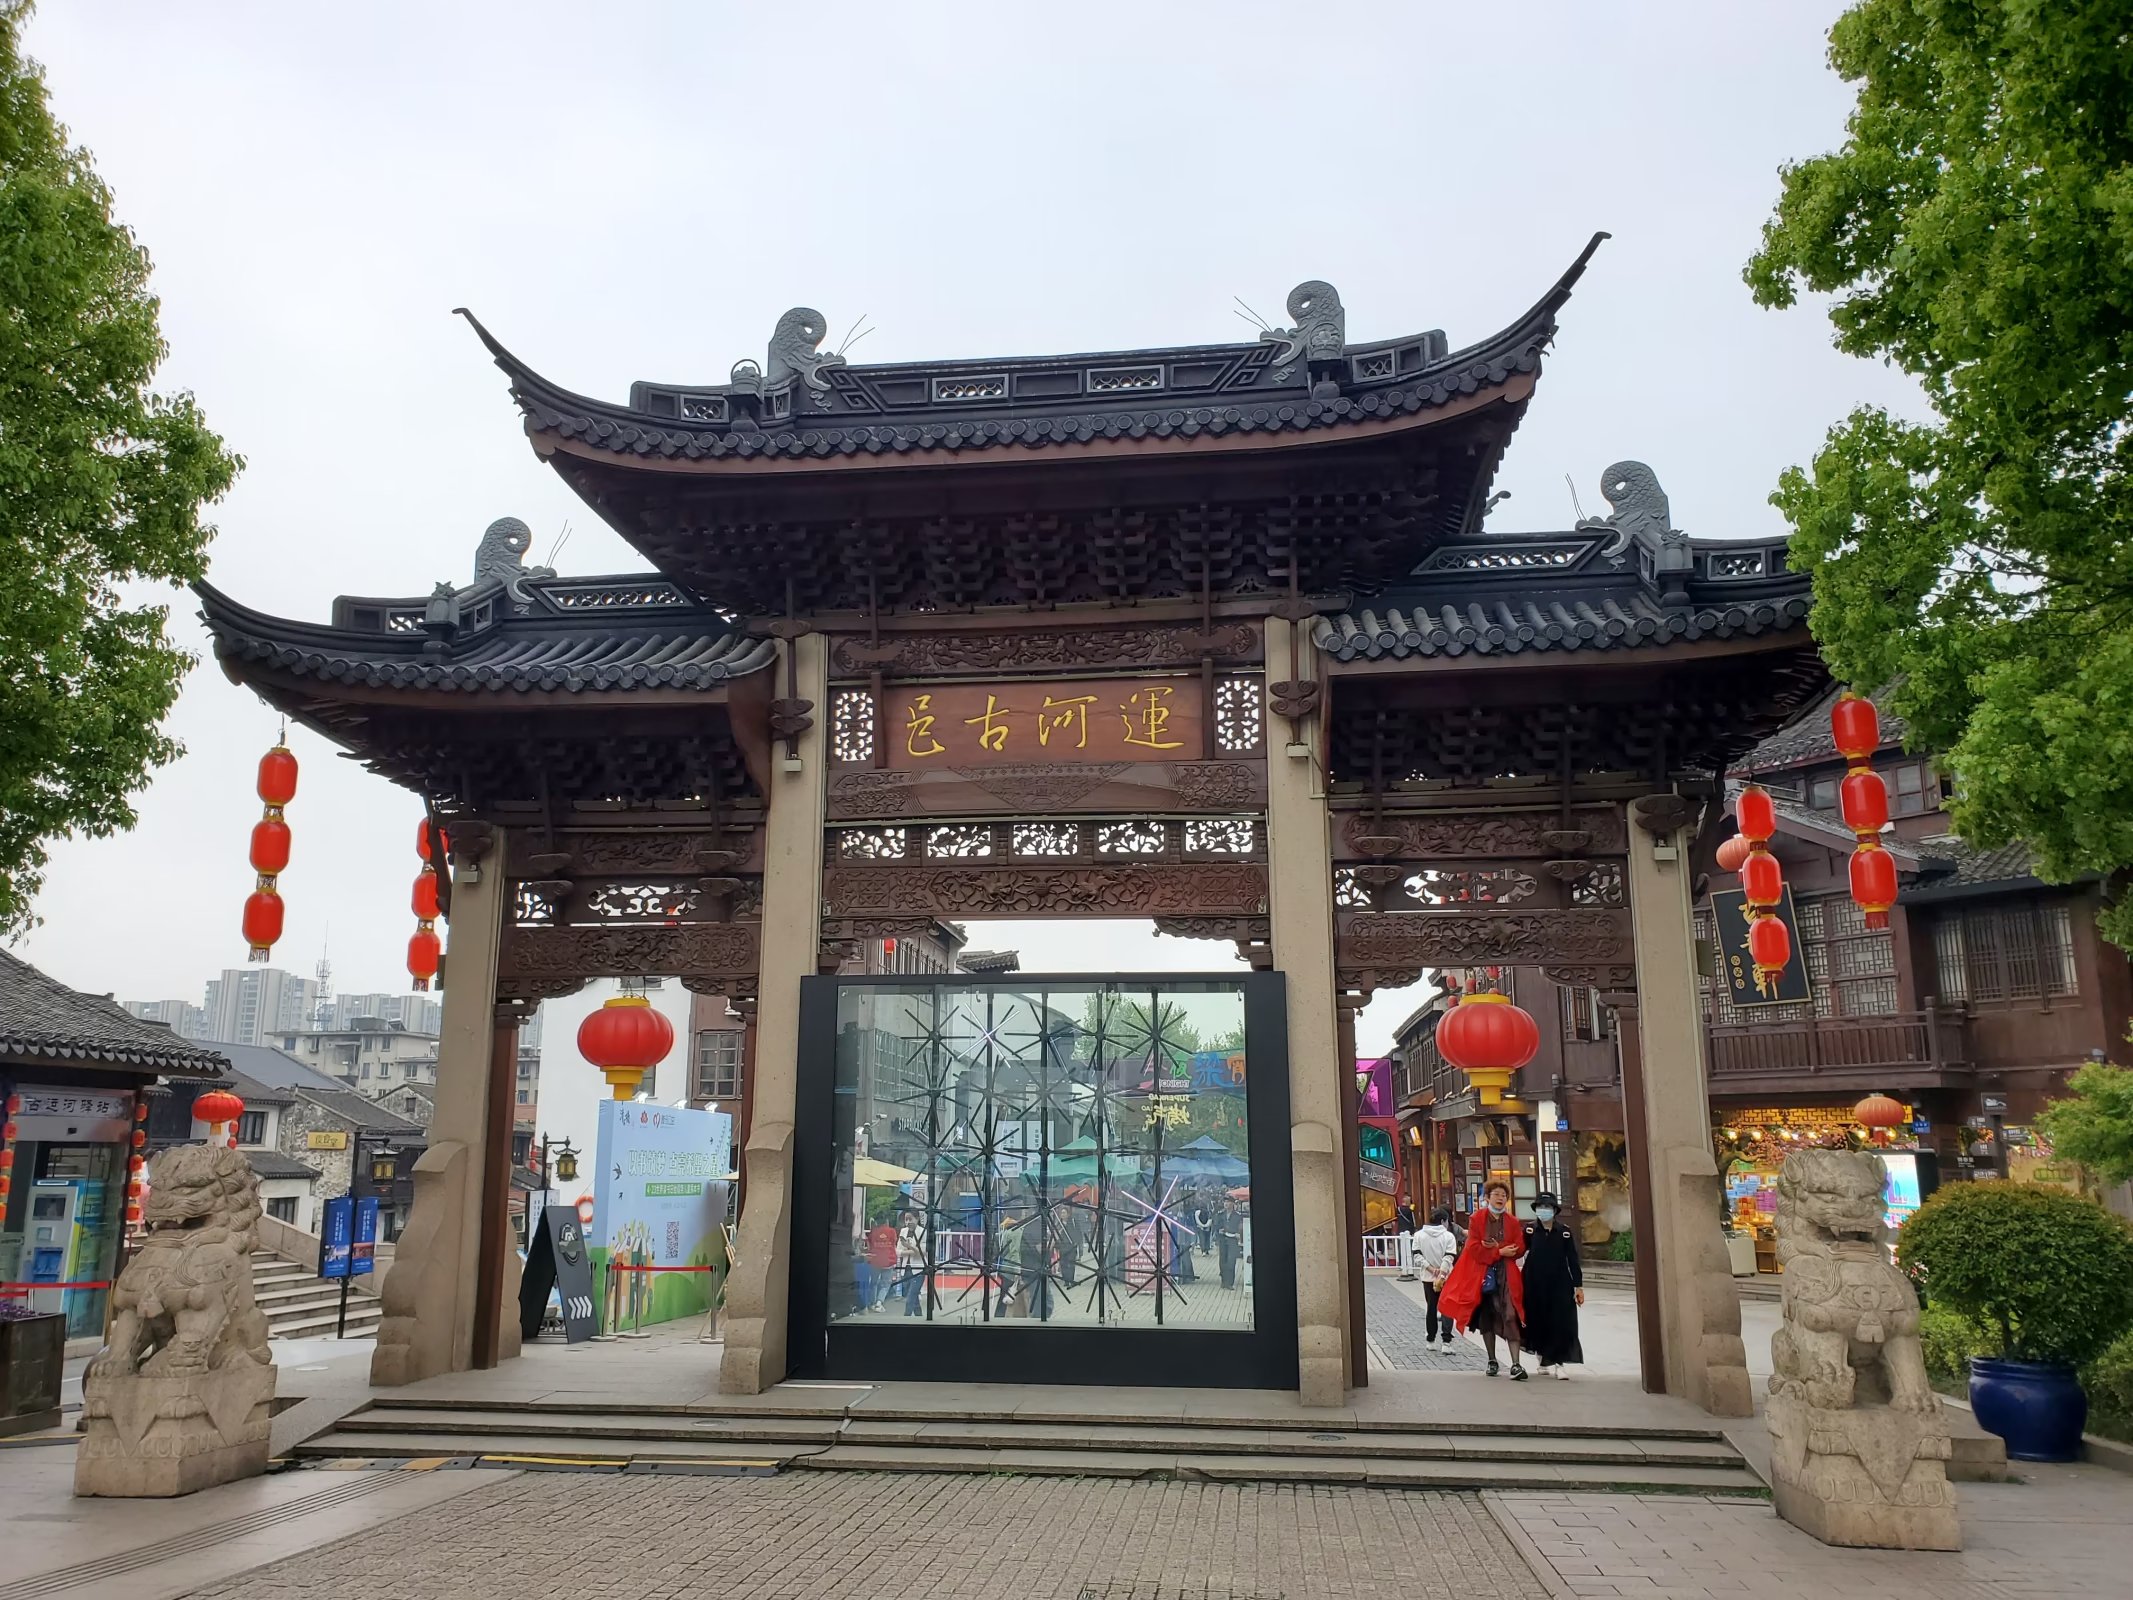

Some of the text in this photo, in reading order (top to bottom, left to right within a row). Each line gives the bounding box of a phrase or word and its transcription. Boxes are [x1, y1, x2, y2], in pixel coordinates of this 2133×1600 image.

[27, 1098, 110, 1113] 古运河驿站
